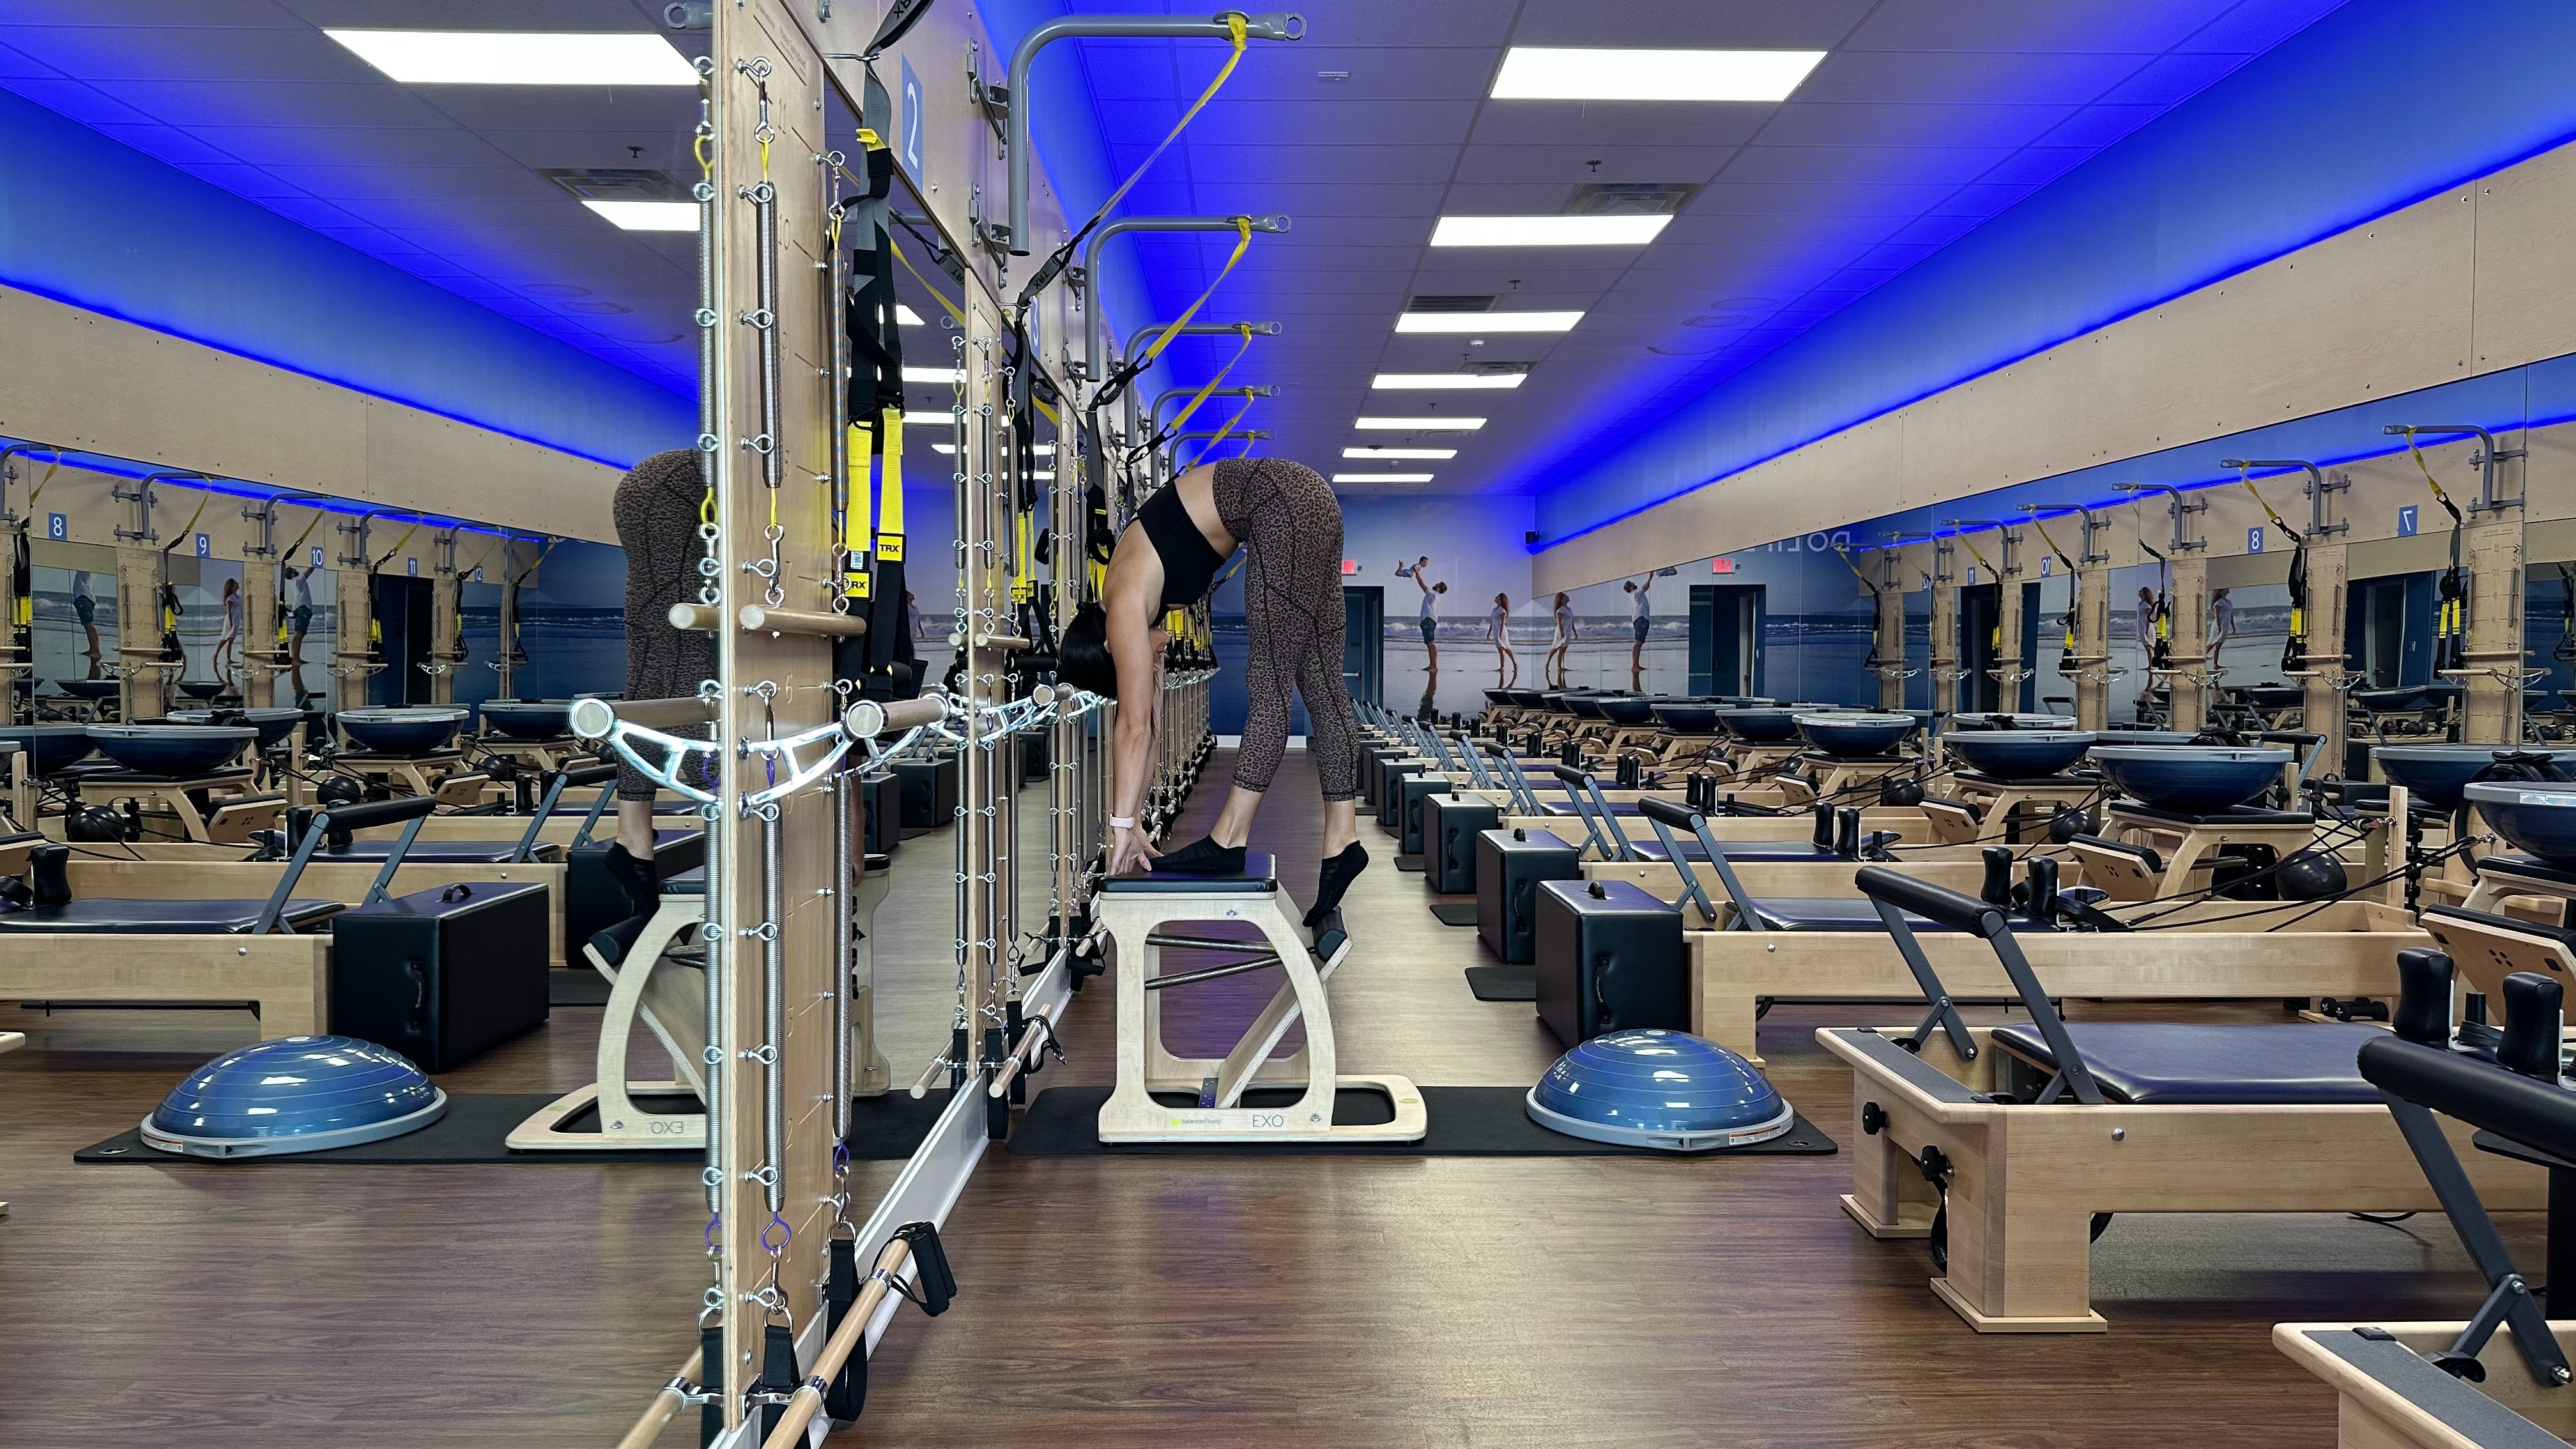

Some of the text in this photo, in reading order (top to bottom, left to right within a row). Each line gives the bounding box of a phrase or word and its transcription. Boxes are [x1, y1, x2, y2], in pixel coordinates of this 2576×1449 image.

[907, 82, 919, 169] 2
[778, 213, 790, 250] 10
[1034, 270, 1049, 289] TRX
[1031, 295, 1039, 348] 3
[54, 517, 63, 537] 8
[199, 537, 206, 555] 9
[879, 544, 900, 552] TRX
[312, 549, 323, 565] 10
[410, 560, 416, 574] 11
[476, 567, 482, 581] 12
[845, 581, 867, 589] RX
[786, 673, 793, 704] 6
[1253, 1115, 1284, 1127] EXO
